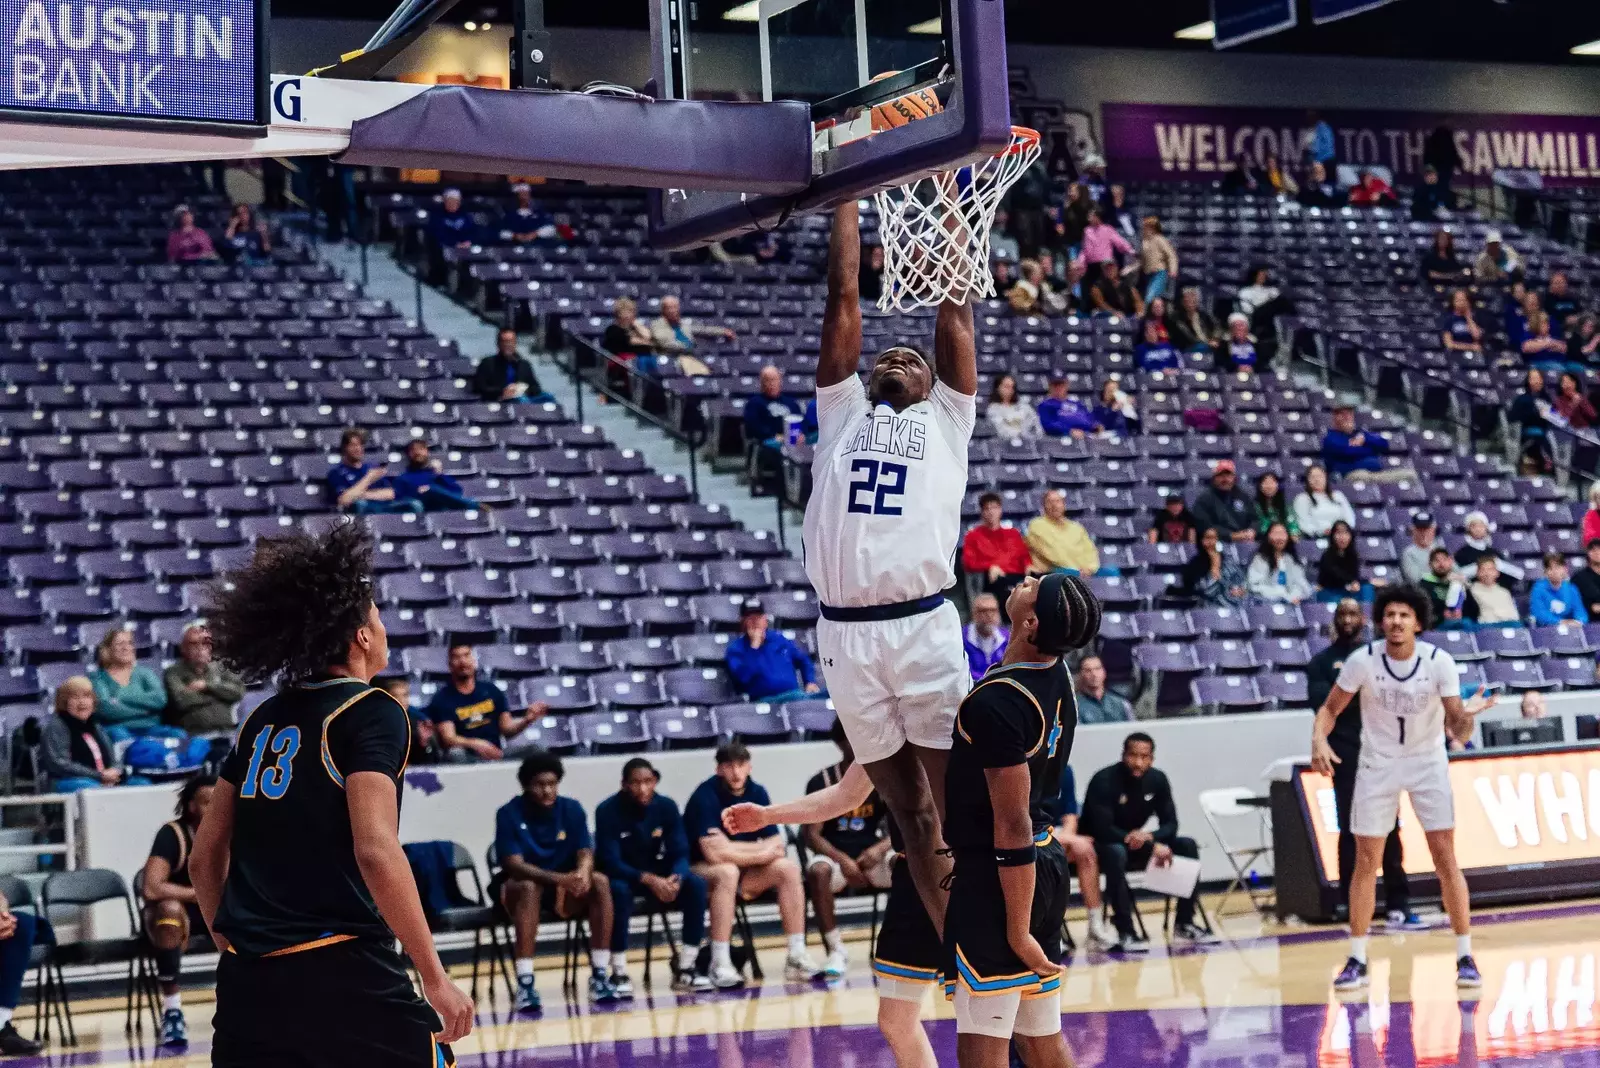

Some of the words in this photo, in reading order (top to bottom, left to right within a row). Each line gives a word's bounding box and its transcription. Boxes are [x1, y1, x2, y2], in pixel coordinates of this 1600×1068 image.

[14, 0, 233, 60] AUSTIN
[13, 53, 164, 109] BANK
[1154, 122, 1313, 173] WELCOM
[1338, 127, 1380, 166] TO
[1382, 128, 1432, 174] TH
[840, 415, 926, 461] JACKS
[848, 458, 908, 516] 22
[1396, 715, 1406, 746] 1
[239, 724, 302, 800] 13
